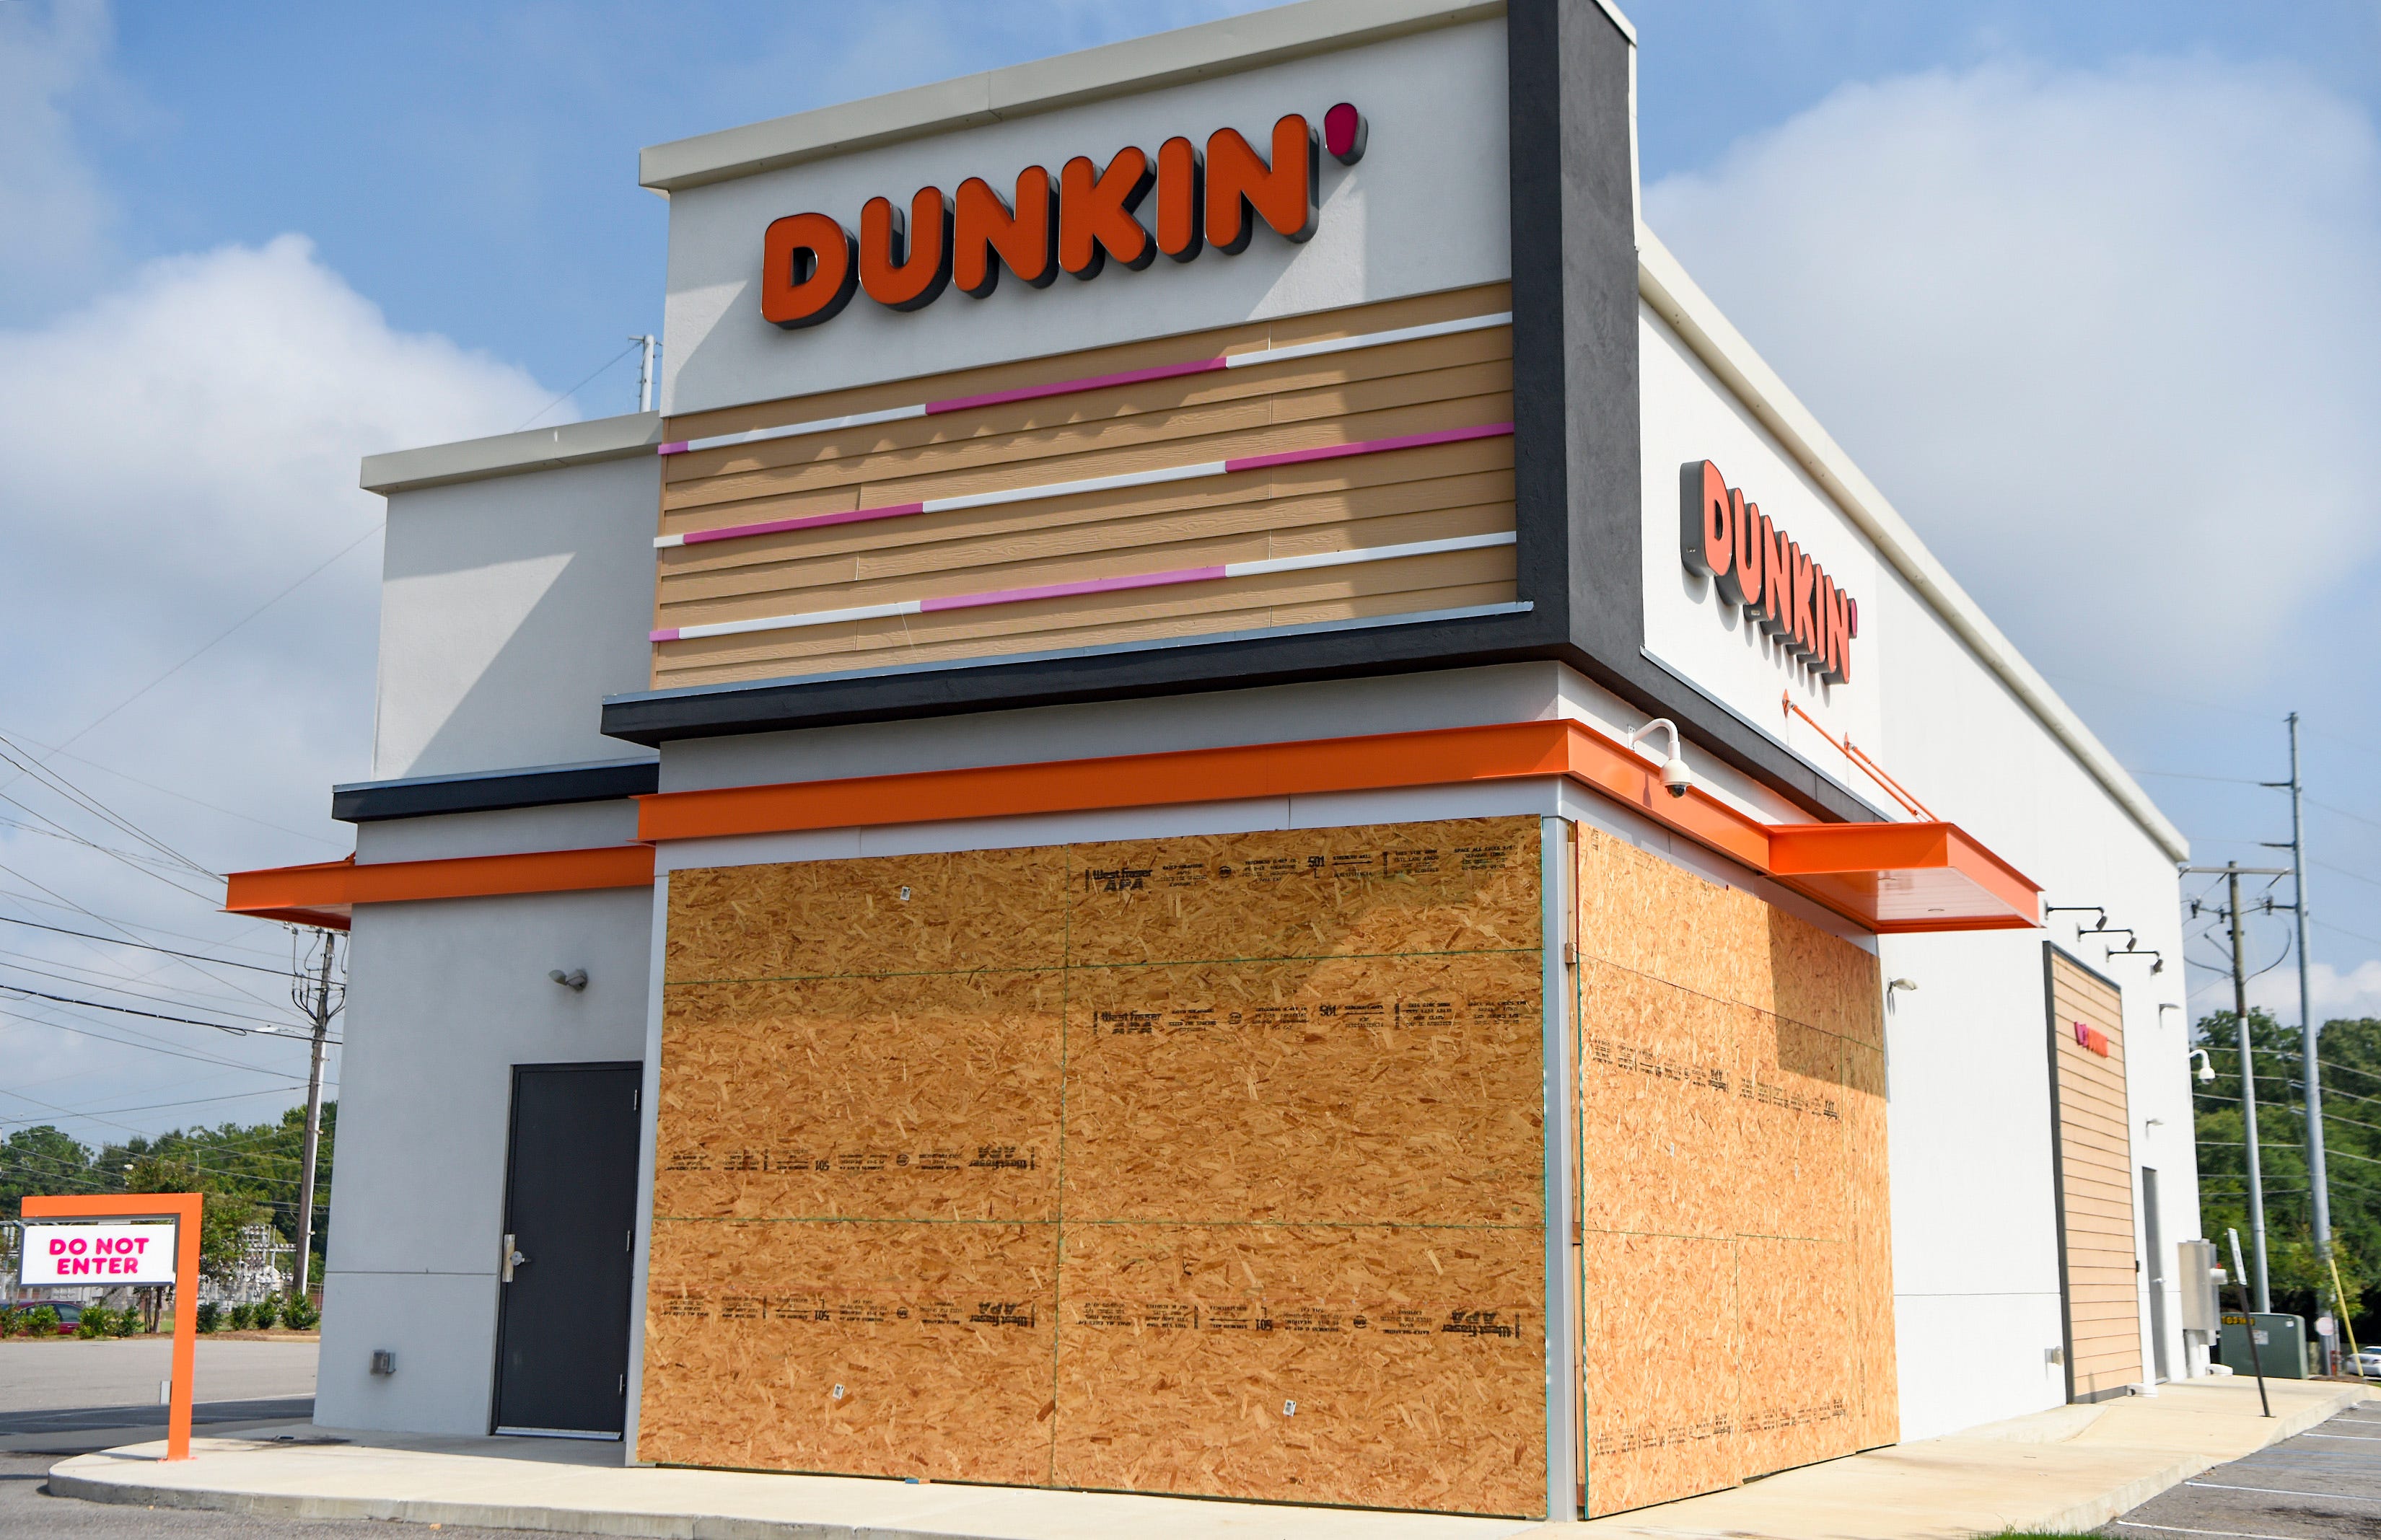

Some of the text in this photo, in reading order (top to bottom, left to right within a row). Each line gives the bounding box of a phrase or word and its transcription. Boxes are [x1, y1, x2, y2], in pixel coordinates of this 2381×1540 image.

[762, 102, 1364, 325] DUNKIN'
[1698, 459, 1858, 685] DUNKIN'
[1103, 876, 1144, 892] APA
[49, 1237, 149, 1255] DO NOT
[57, 1257, 138, 1275] ENTER
